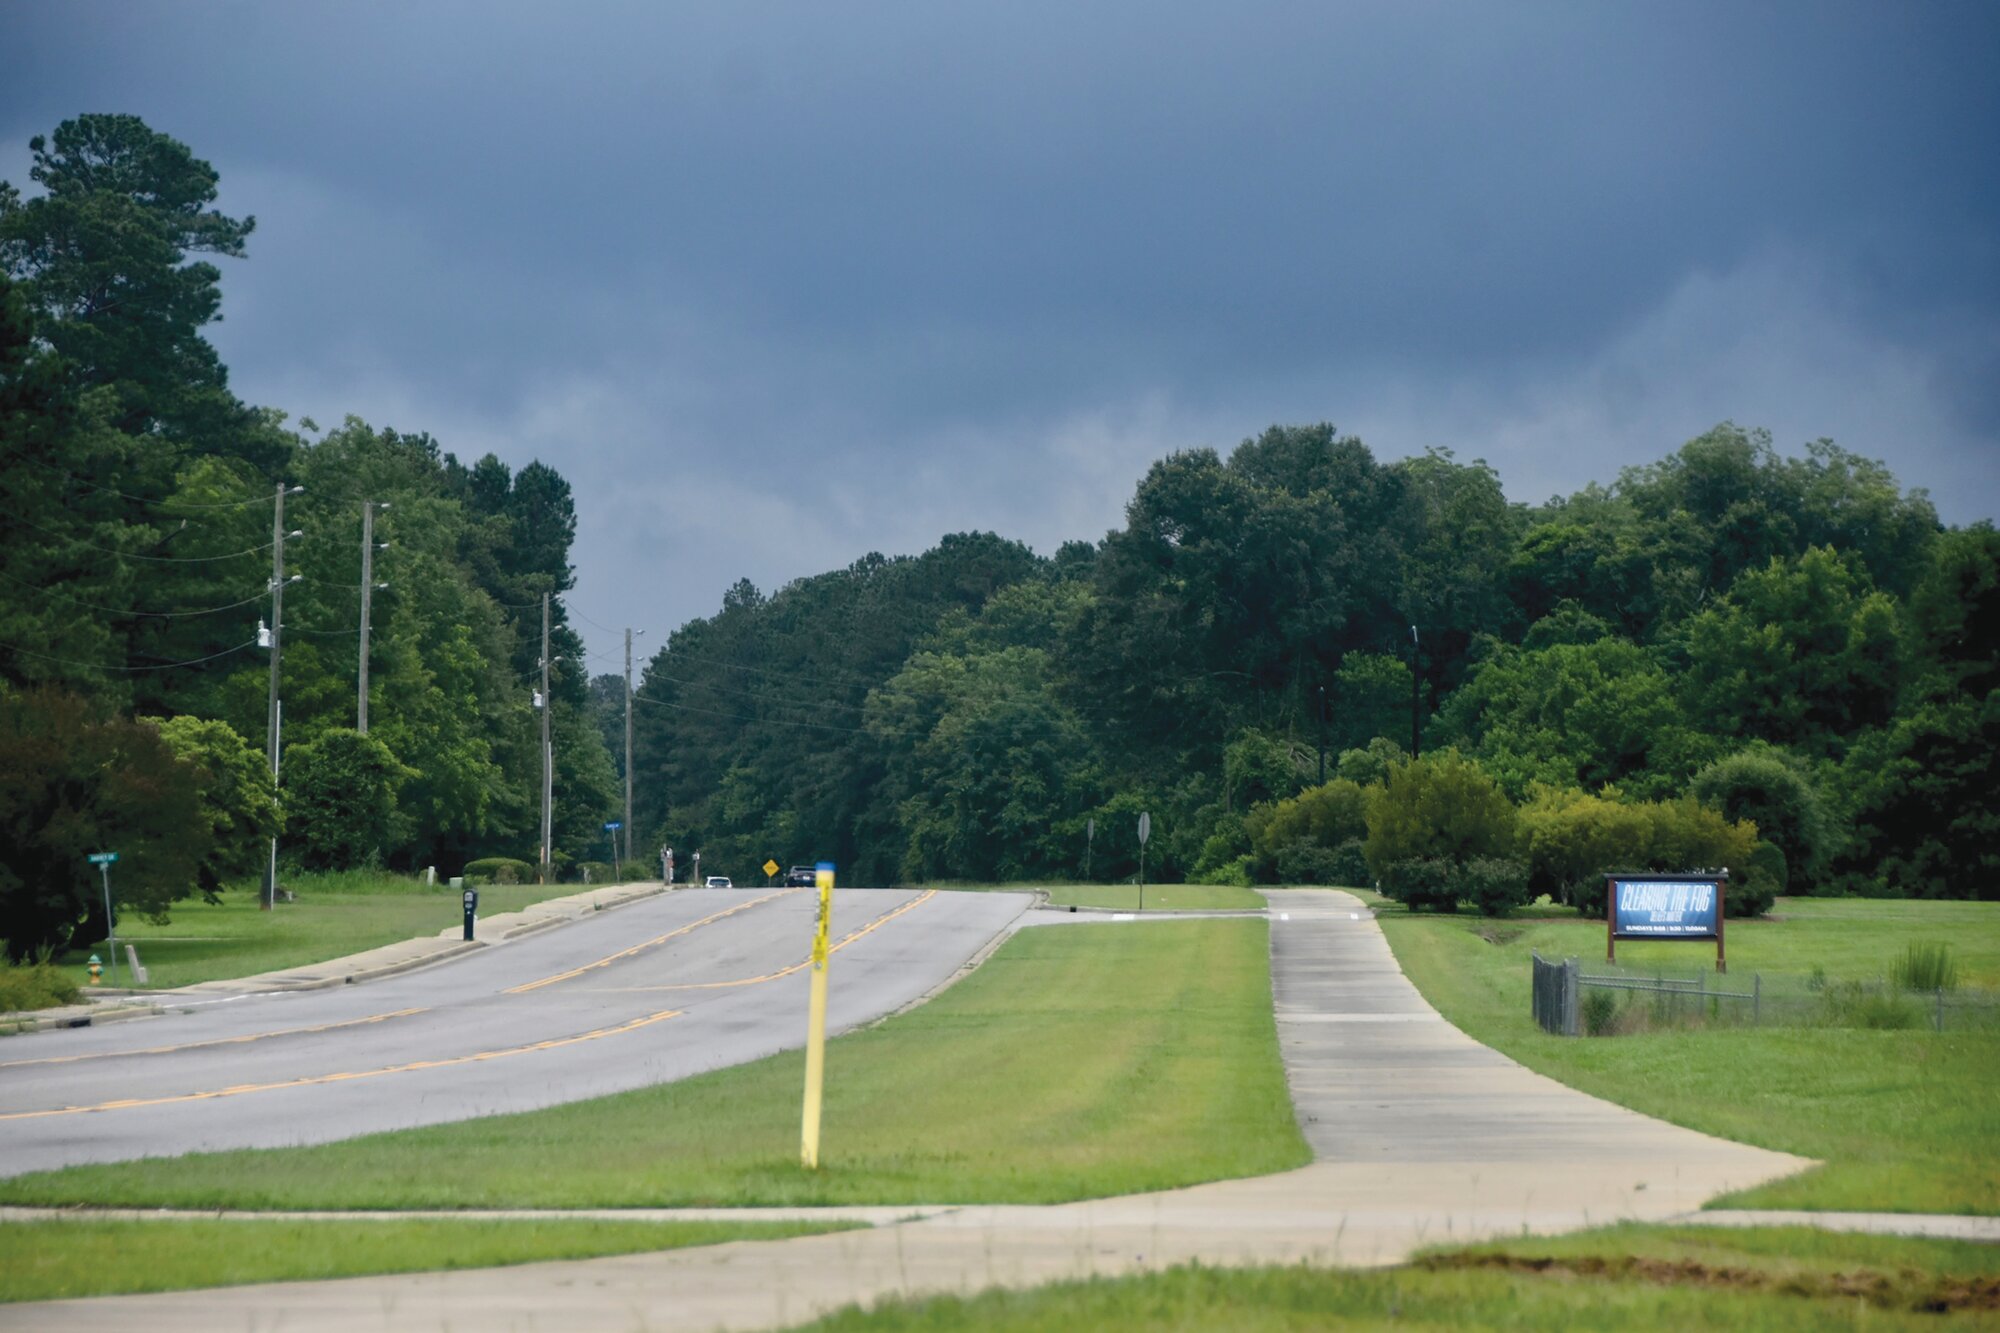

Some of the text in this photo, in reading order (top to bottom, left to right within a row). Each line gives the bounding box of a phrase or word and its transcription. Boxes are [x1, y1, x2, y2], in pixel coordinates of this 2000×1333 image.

[1621, 884, 1712, 912] CLEARING THE FOG
